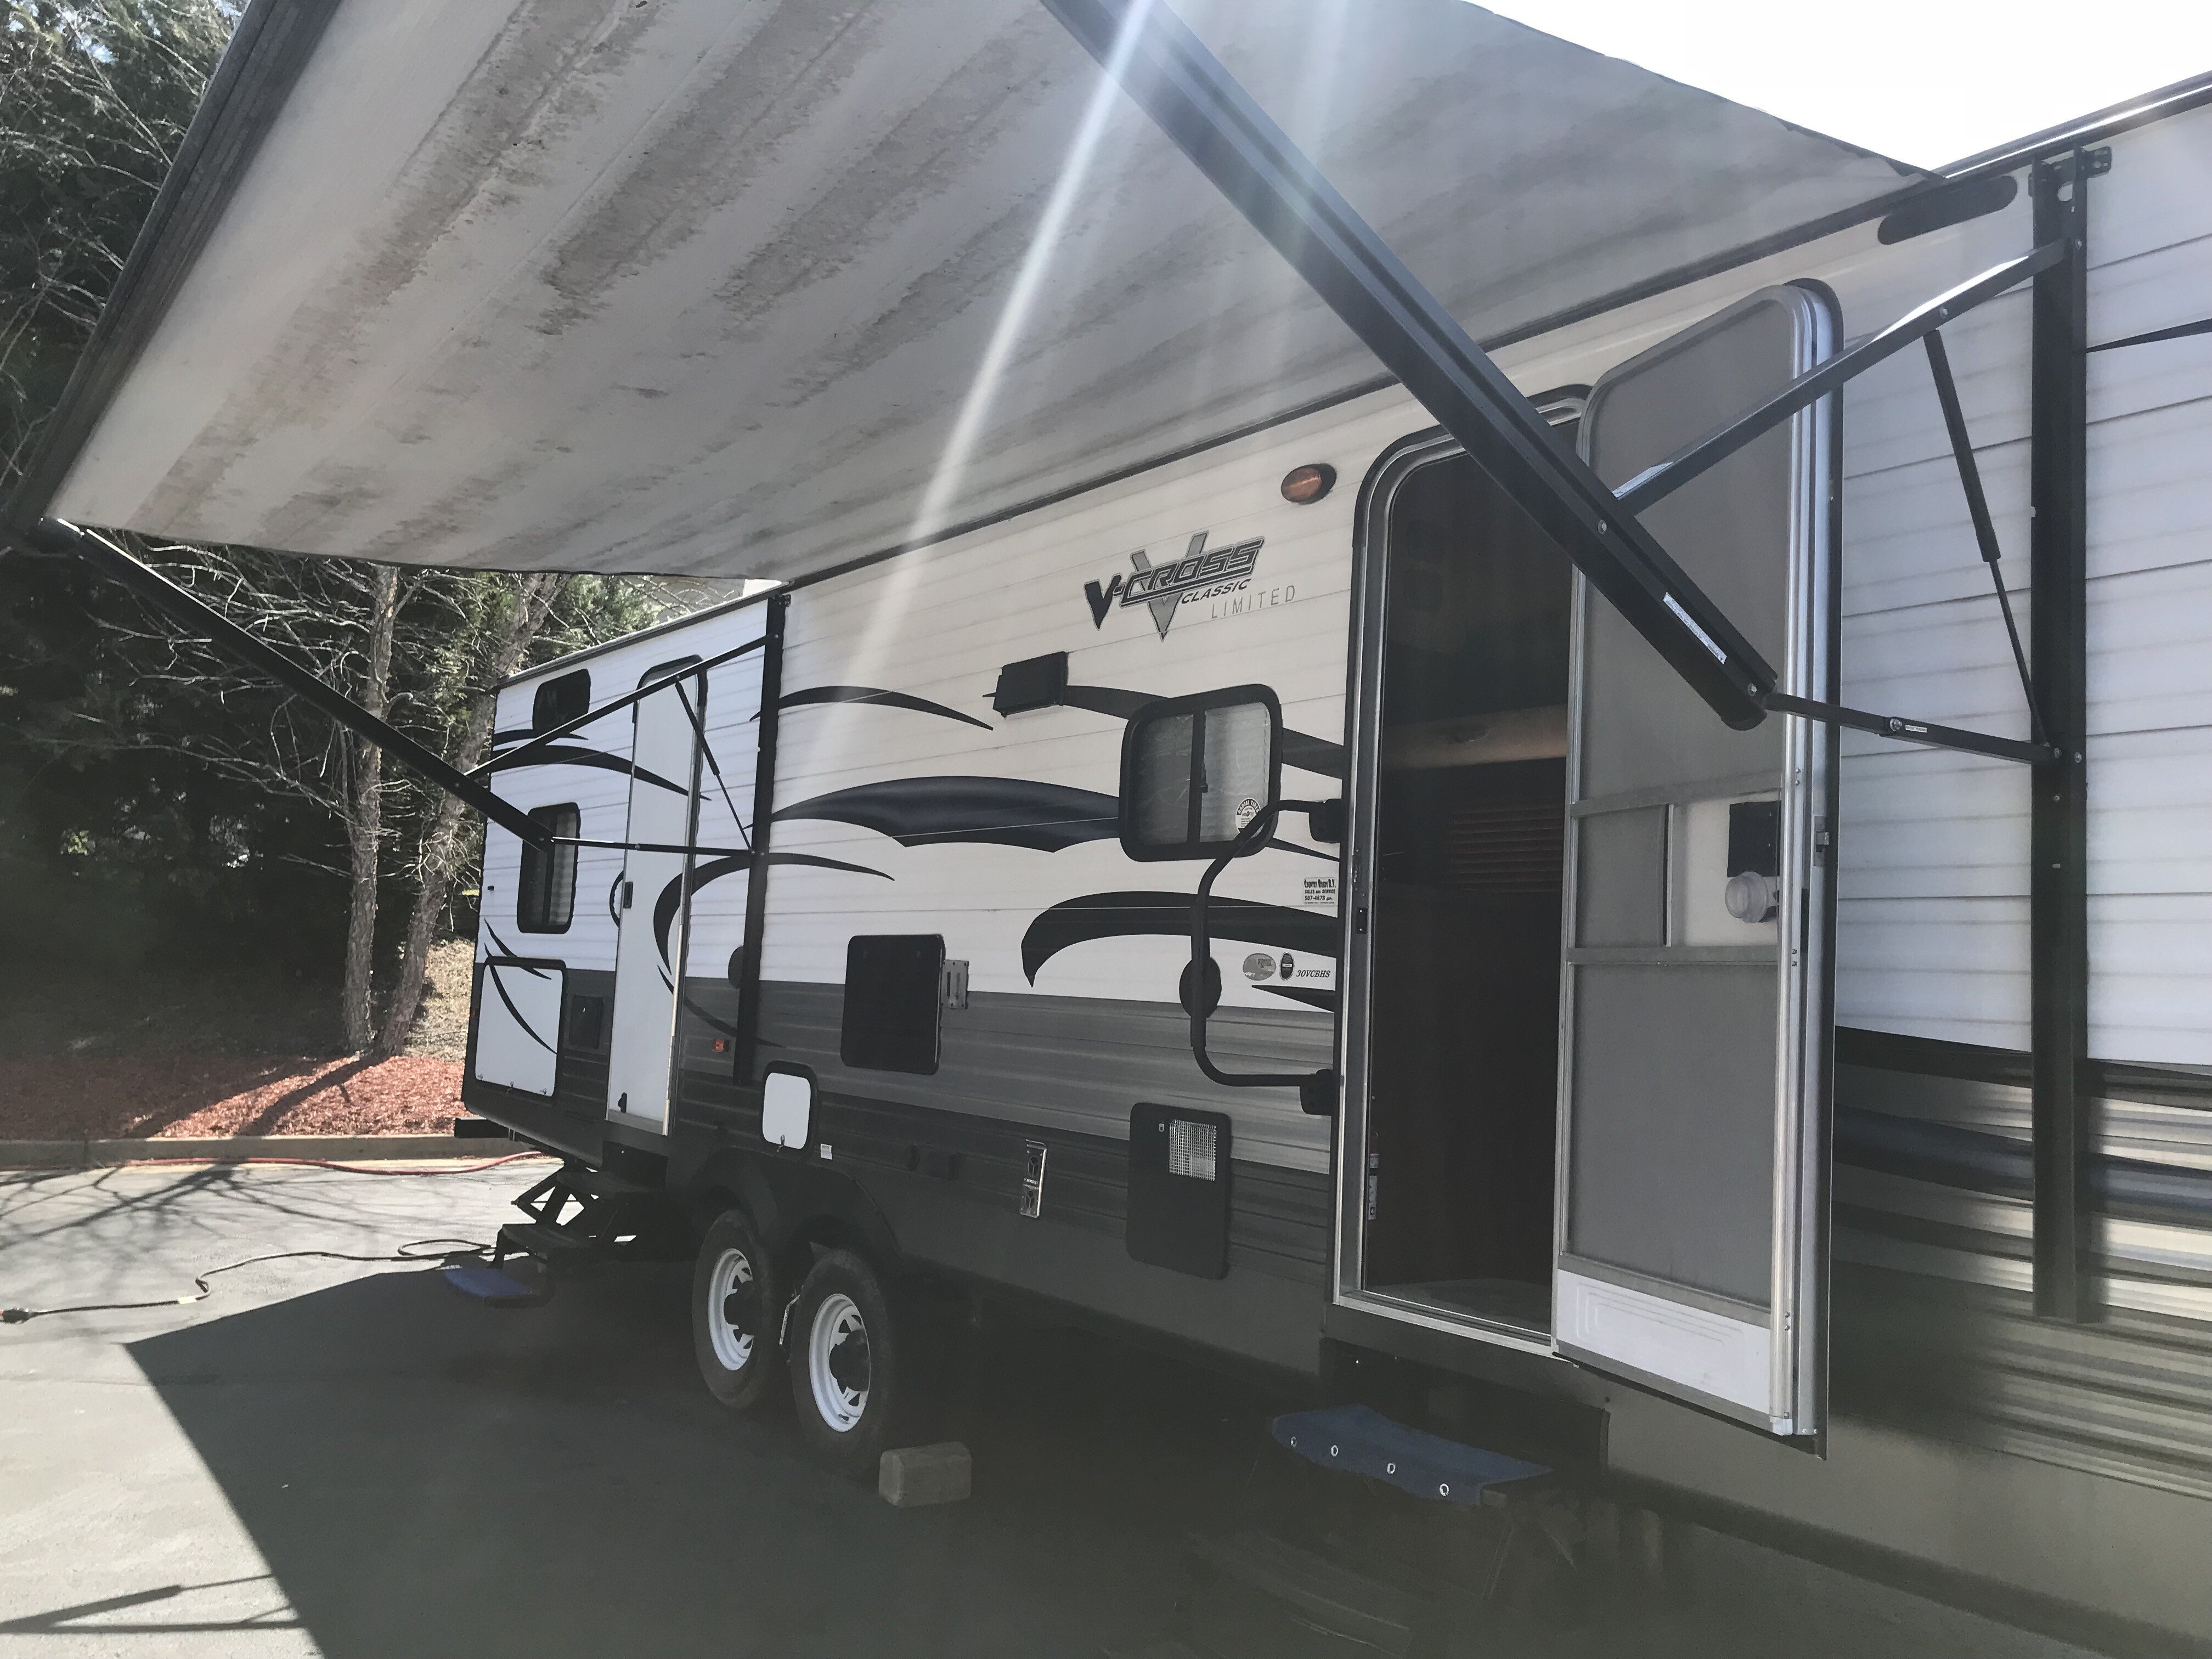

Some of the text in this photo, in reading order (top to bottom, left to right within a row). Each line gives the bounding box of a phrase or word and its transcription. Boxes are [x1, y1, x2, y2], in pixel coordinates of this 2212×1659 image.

[1181, 578, 1251, 604] CLASSIC
[1211, 585, 1295, 619] LIMITED
[1296, 969, 1331, 978] 30VCBHS
